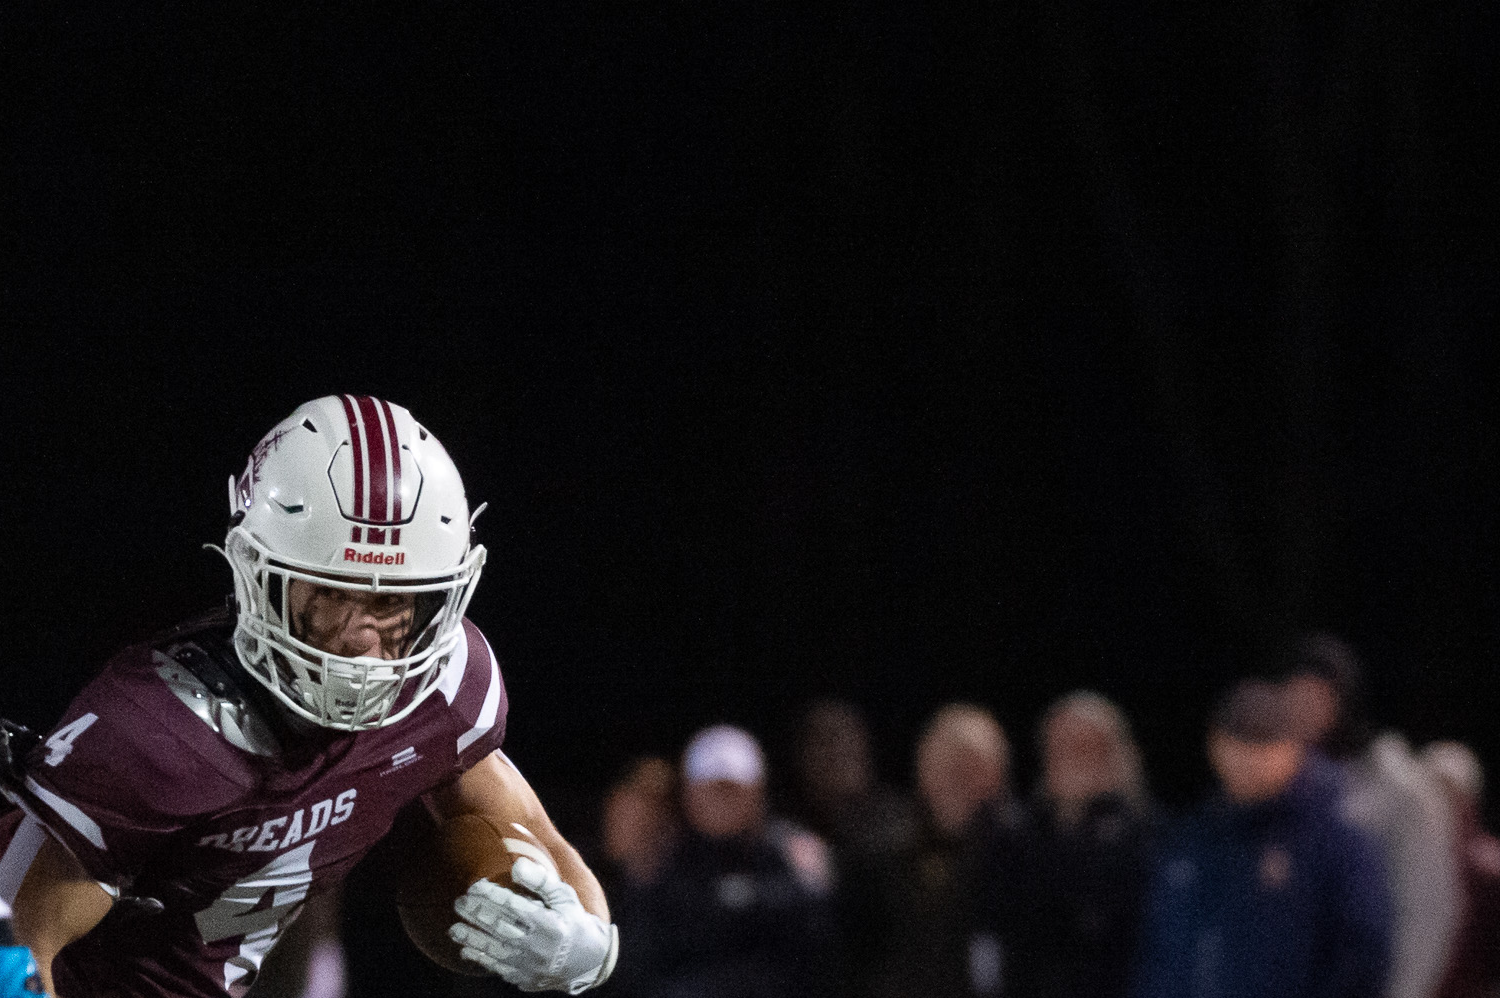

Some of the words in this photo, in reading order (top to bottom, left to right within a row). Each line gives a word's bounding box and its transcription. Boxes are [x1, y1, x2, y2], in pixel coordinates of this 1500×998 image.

[344, 548, 405, 565] Riddell
[44, 712, 99, 767] 4
[194, 838, 317, 990] 4
